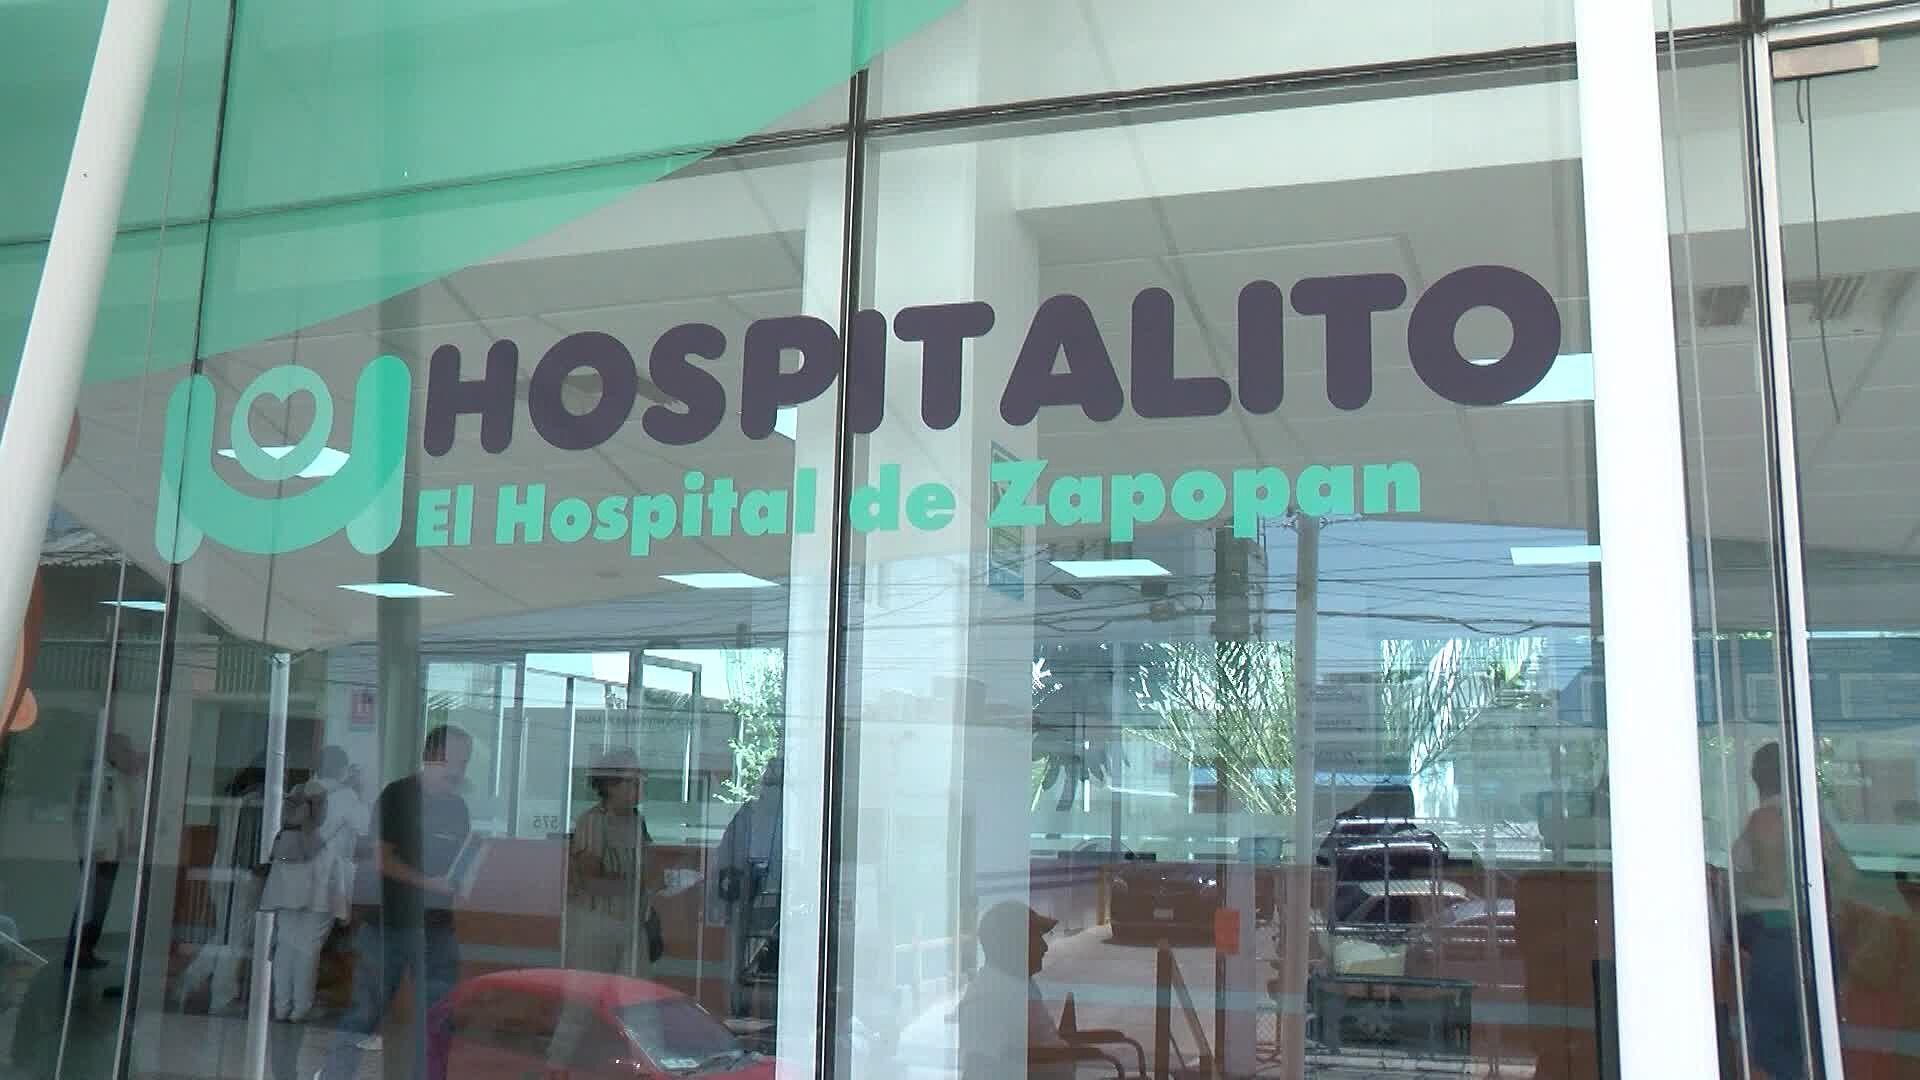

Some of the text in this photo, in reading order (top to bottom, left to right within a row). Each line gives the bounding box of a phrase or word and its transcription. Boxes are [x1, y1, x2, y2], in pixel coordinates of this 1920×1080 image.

[424, 265, 1561, 456] HOSPITALITO
[415, 459, 1421, 556] El Hospital de Zapopan
